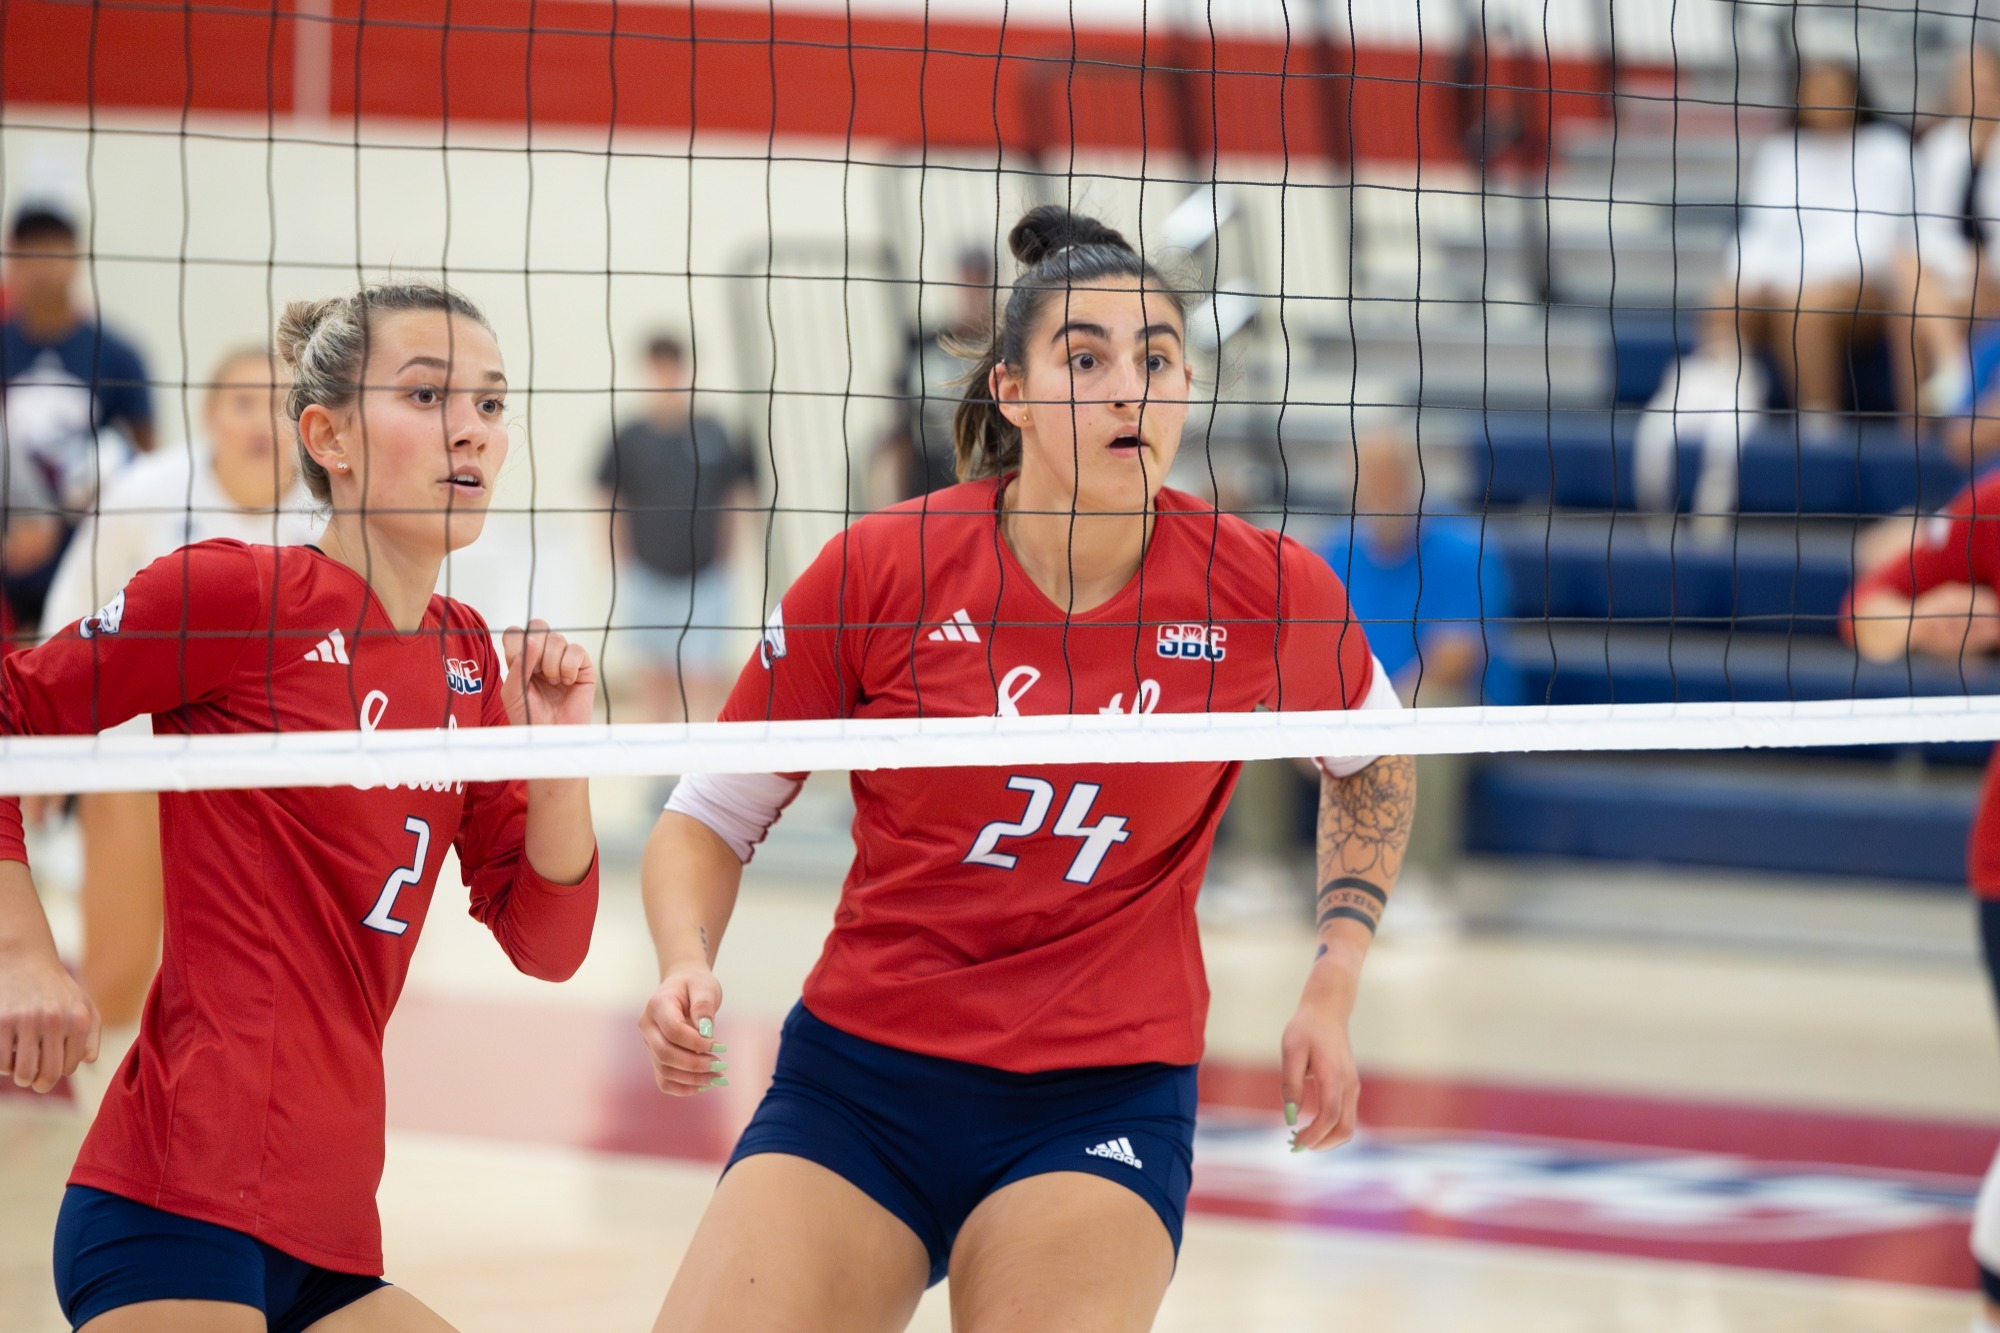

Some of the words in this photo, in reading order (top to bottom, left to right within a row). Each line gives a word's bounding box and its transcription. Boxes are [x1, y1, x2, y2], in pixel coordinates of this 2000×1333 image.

[1156, 624, 1227, 662] SBC
[360, 814, 430, 937] 2
[961, 774, 1132, 885] 24
